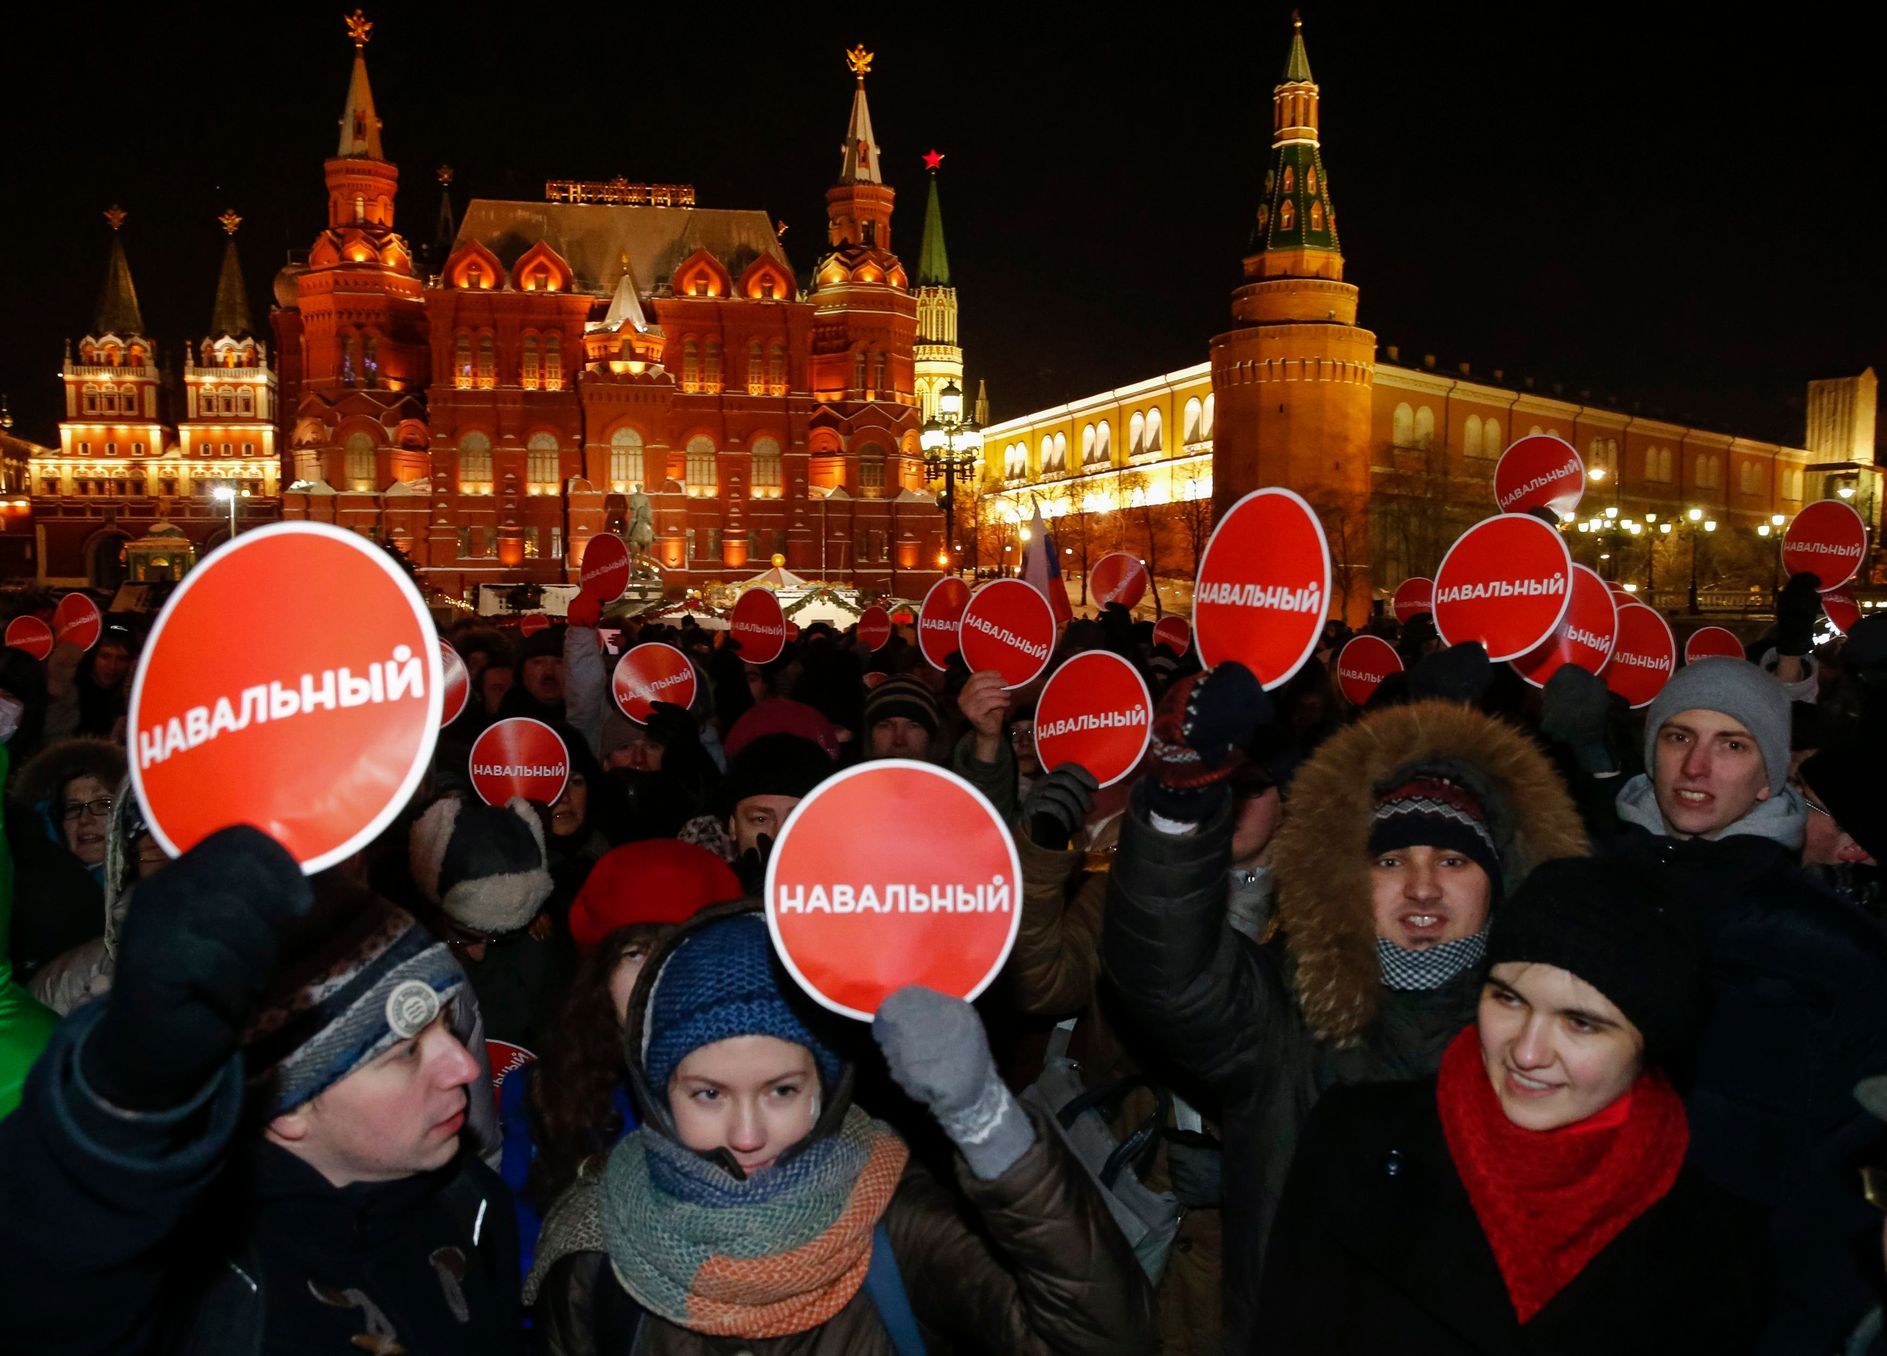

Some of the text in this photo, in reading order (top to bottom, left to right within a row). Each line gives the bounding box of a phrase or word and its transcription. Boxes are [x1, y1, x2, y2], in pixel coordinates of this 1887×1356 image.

[1501, 459, 1580, 508] НАВАЛЬНЫЙ
[1783, 542, 1861, 557] НАВАЛЬНЫЙ
[1198, 581, 1320, 614] НАВАЛЬНЫЙ
[1437, 572, 1564, 604] НАВАЛЬНЫЙ
[921, 618, 961, 632] НАВАЛ
[965, 613, 1048, 660] НАВАЛЬНЫЙ
[140, 644, 425, 770] НАВАЛЬНЫЙ
[1038, 704, 1146, 740] НАВАЛЬНЫЙ
[474, 761, 566, 777] НАВАЛЬНЫЙ
[779, 874, 1010, 914] НАВАЛЬНЫЙ
